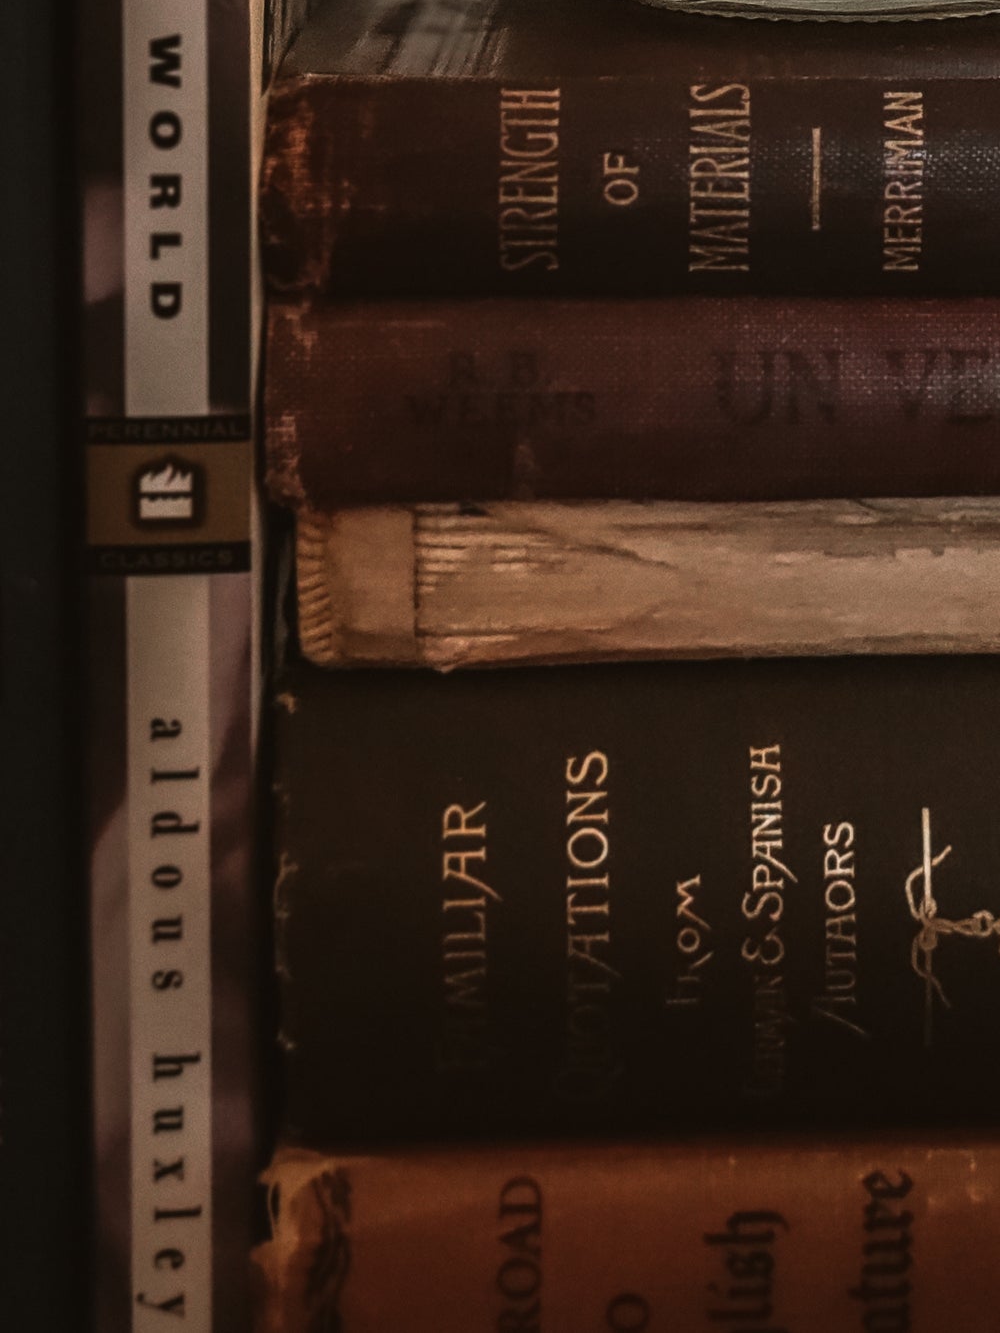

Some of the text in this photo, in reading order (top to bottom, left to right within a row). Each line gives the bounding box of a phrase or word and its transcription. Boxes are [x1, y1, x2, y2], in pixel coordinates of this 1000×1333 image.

[147, 33, 183, 320] WORLD
[500, 86, 561, 271] STRENGTH
[604, 150, 639, 207] OF
[689, 82, 750, 272] MATERIALS
[884, 90, 923, 272] MERRIMAN
[98, 548, 234, 569] CLASSICS
[741, 744, 798, 923] SPANISH
[137, 716, 202, 1319] aldous huxley
